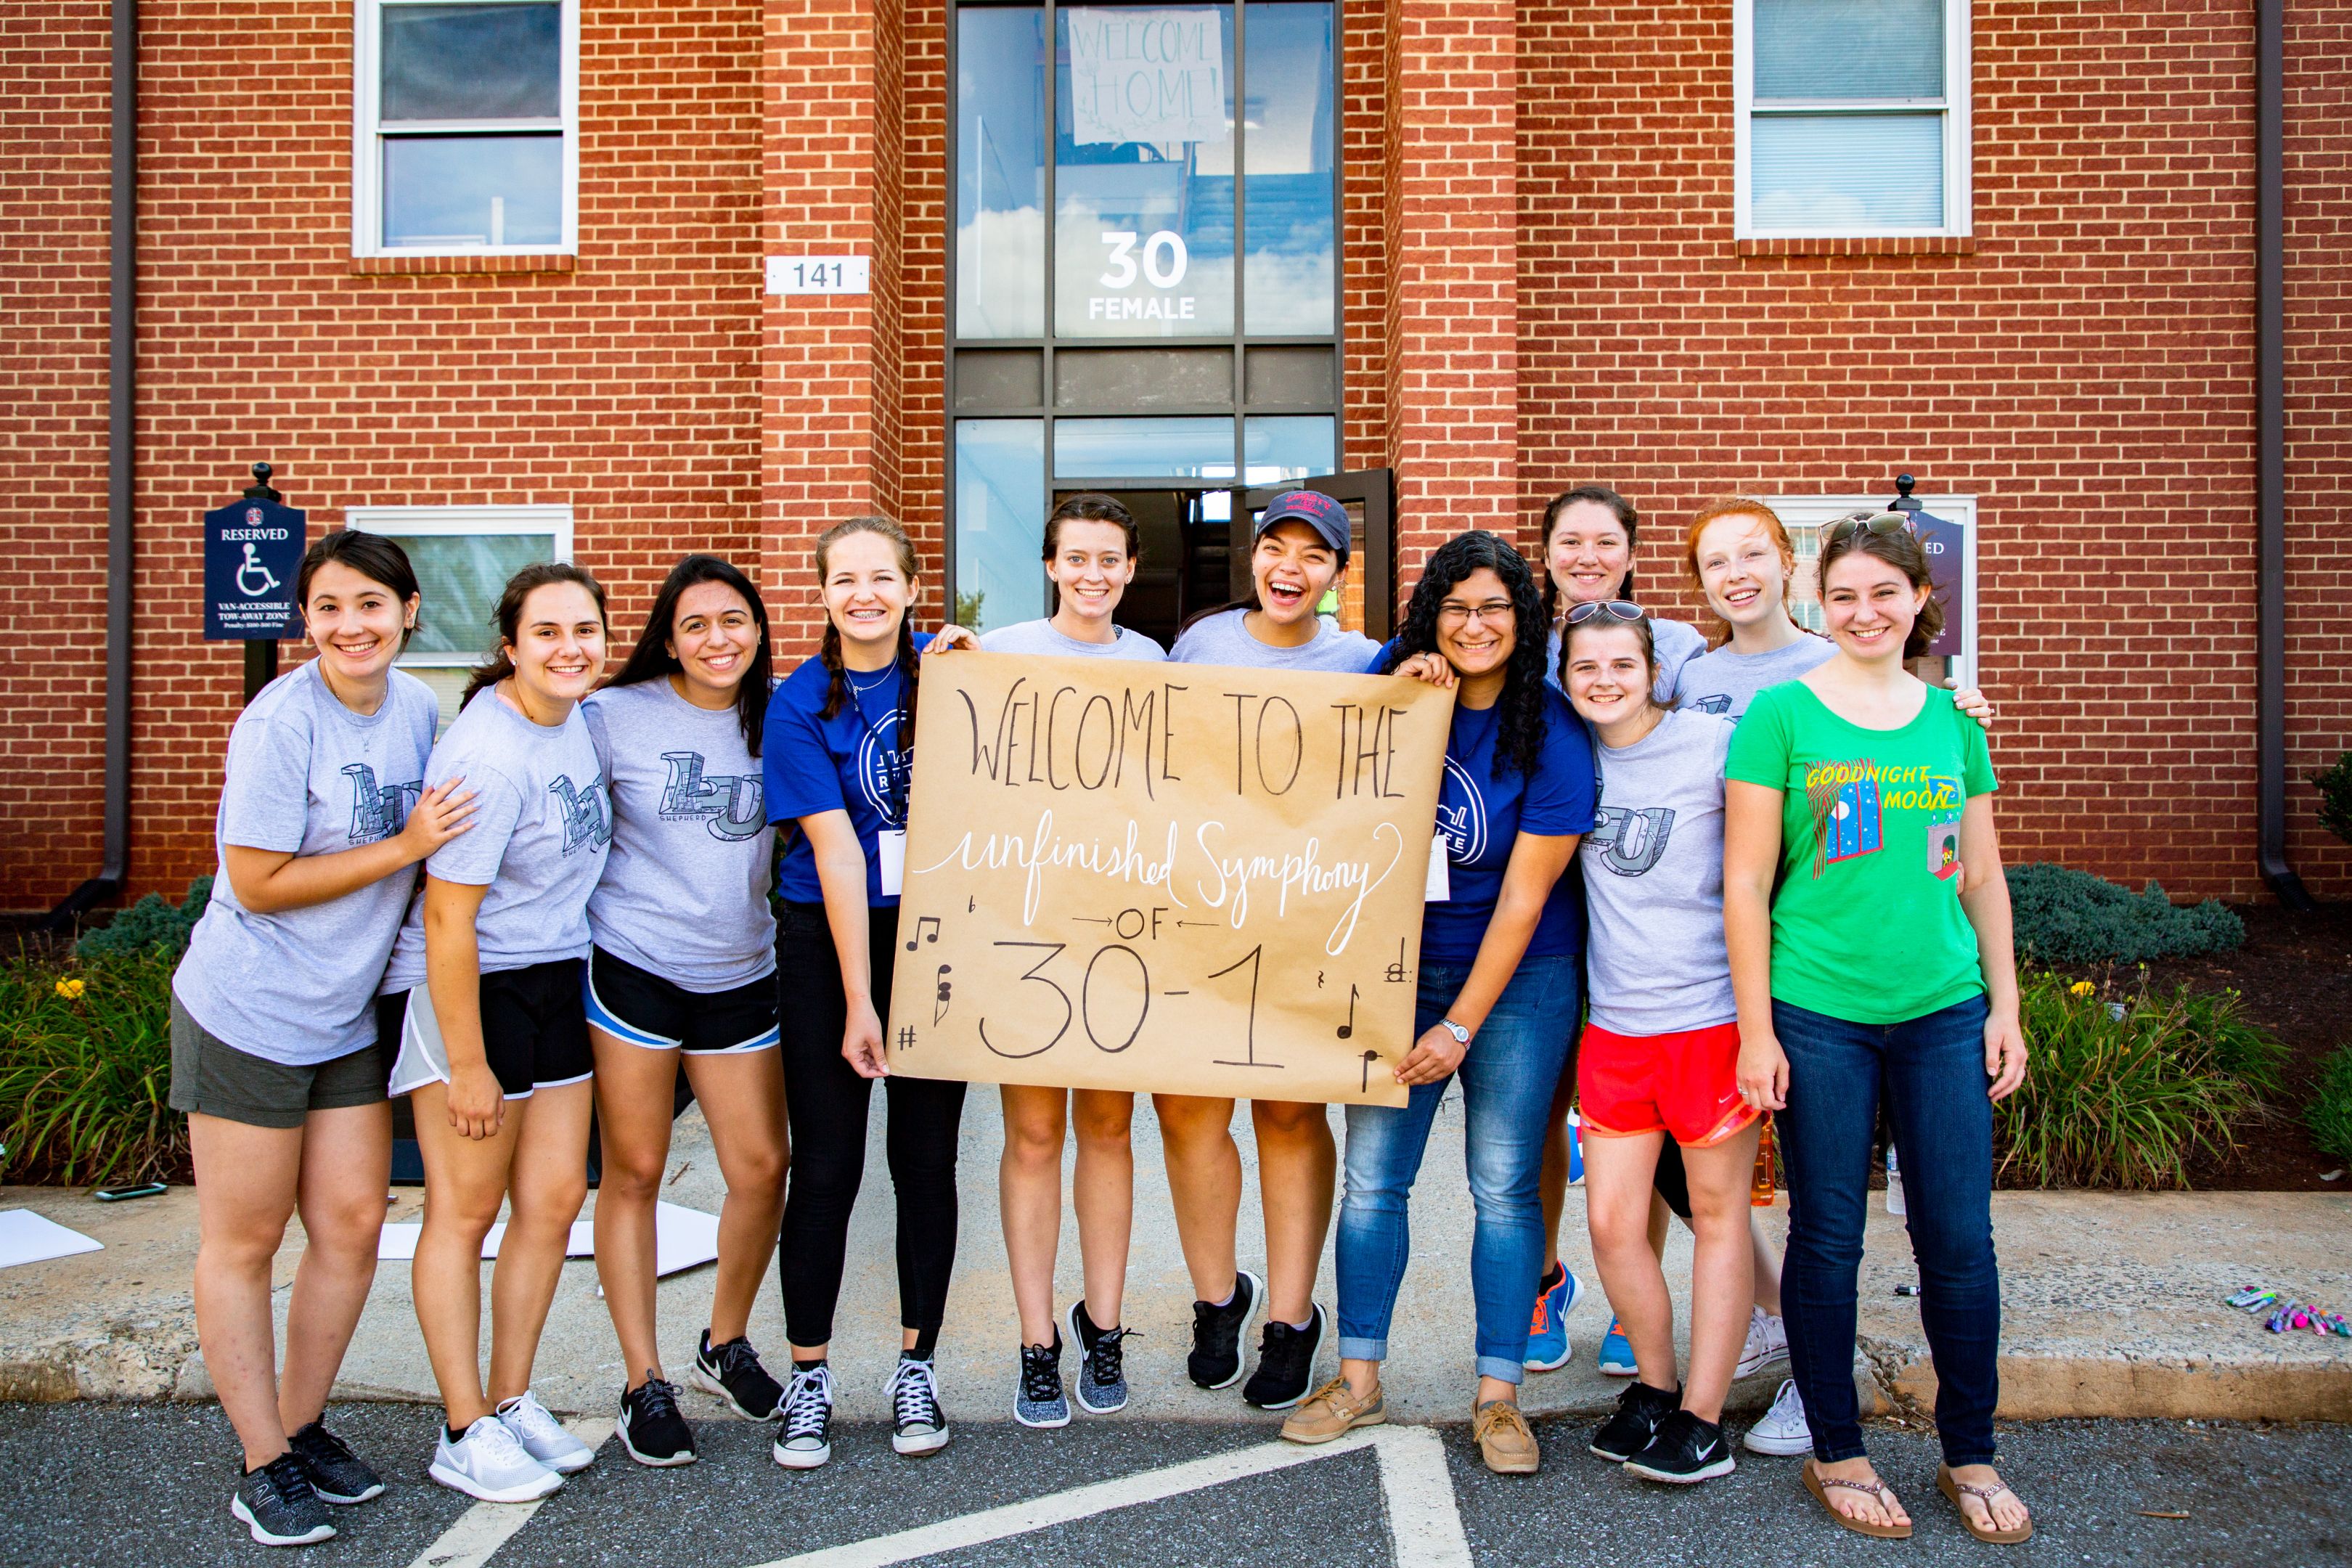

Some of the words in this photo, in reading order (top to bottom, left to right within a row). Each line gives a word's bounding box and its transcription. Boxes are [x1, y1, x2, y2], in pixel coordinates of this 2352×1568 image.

[1074, 18, 1214, 64] WELCOME
[1088, 66, 1217, 118] HOME!
[1098, 230, 1188, 289] 30
[793, 263, 842, 287] 141
[1089, 297, 1196, 319] FEMALE
[221, 528, 289, 541] RESERVED
[218, 602, 290, 611] VAN-ACCESSIBLE
[218, 612, 264, 621] TOW-AWAY
[956, 677, 1189, 801] WELCOME
[1223, 693, 1303, 796] TO
[1331, 704, 1408, 800] THE
[1806, 766, 1931, 788] GOODNIGHT
[1884, 790, 1951, 811] MOON
[563, 835, 593, 858] SHEPHERD
[912, 809, 1188, 926] unfinished
[1197, 820, 1402, 956] Symphony
[1116, 907, 1169, 939] OF
[979, 942, 1285, 1069] 30-1
